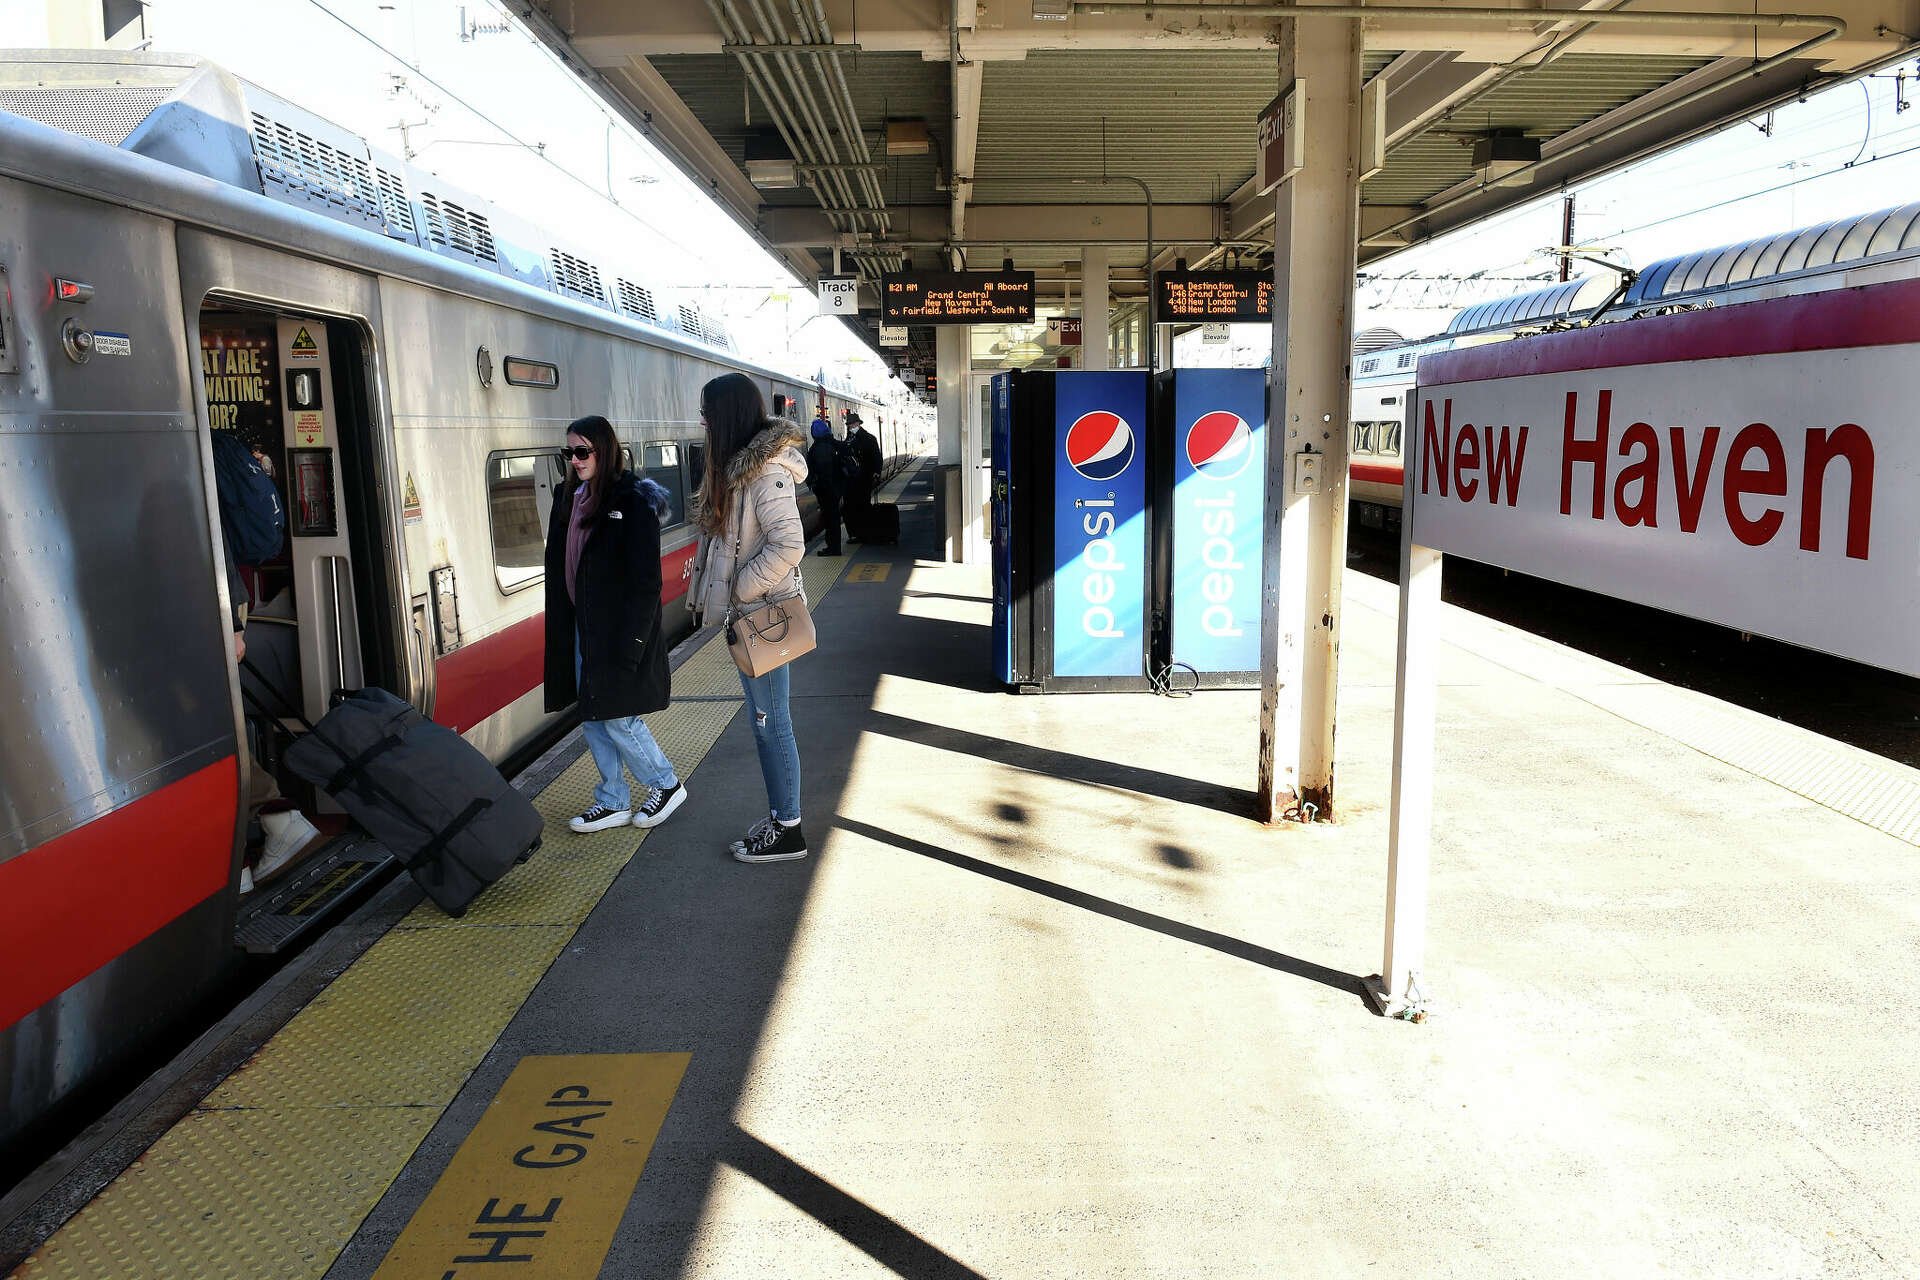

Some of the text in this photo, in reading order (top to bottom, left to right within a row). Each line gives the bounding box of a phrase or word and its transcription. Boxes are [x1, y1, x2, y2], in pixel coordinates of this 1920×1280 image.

[1265, 106, 1284, 147] Exit
[820, 281, 856, 292] Track
[906, 283, 918, 292] AM
[984, 282, 1028, 291] All Aboard
[1165, 281, 1274, 290] Time Destination Sta
[927, 290, 989, 299] Grand Central
[1172, 289, 1268, 298] 1:46 Grand Central On
[834, 296, 843, 307] 8
[925, 298, 993, 307] New Haven Line
[1168, 298, 1268, 306] 4:40 New London On
[991, 305, 1015, 314] South
[1172, 305, 1268, 314] 5:18 New London On
[1061, 321, 1082, 332] Exi
[880, 334, 908, 342] Elevator
[225, 348, 262, 374] ARE
[208, 403, 238, 430] OR?
[1421, 389, 1875, 560] New Haven
[1074, 498, 1126, 638] pepsi
[1194, 498, 1244, 638] pepsi
[512, 1085, 613, 1169] GAP
[441, 1197, 563, 1280] HE
